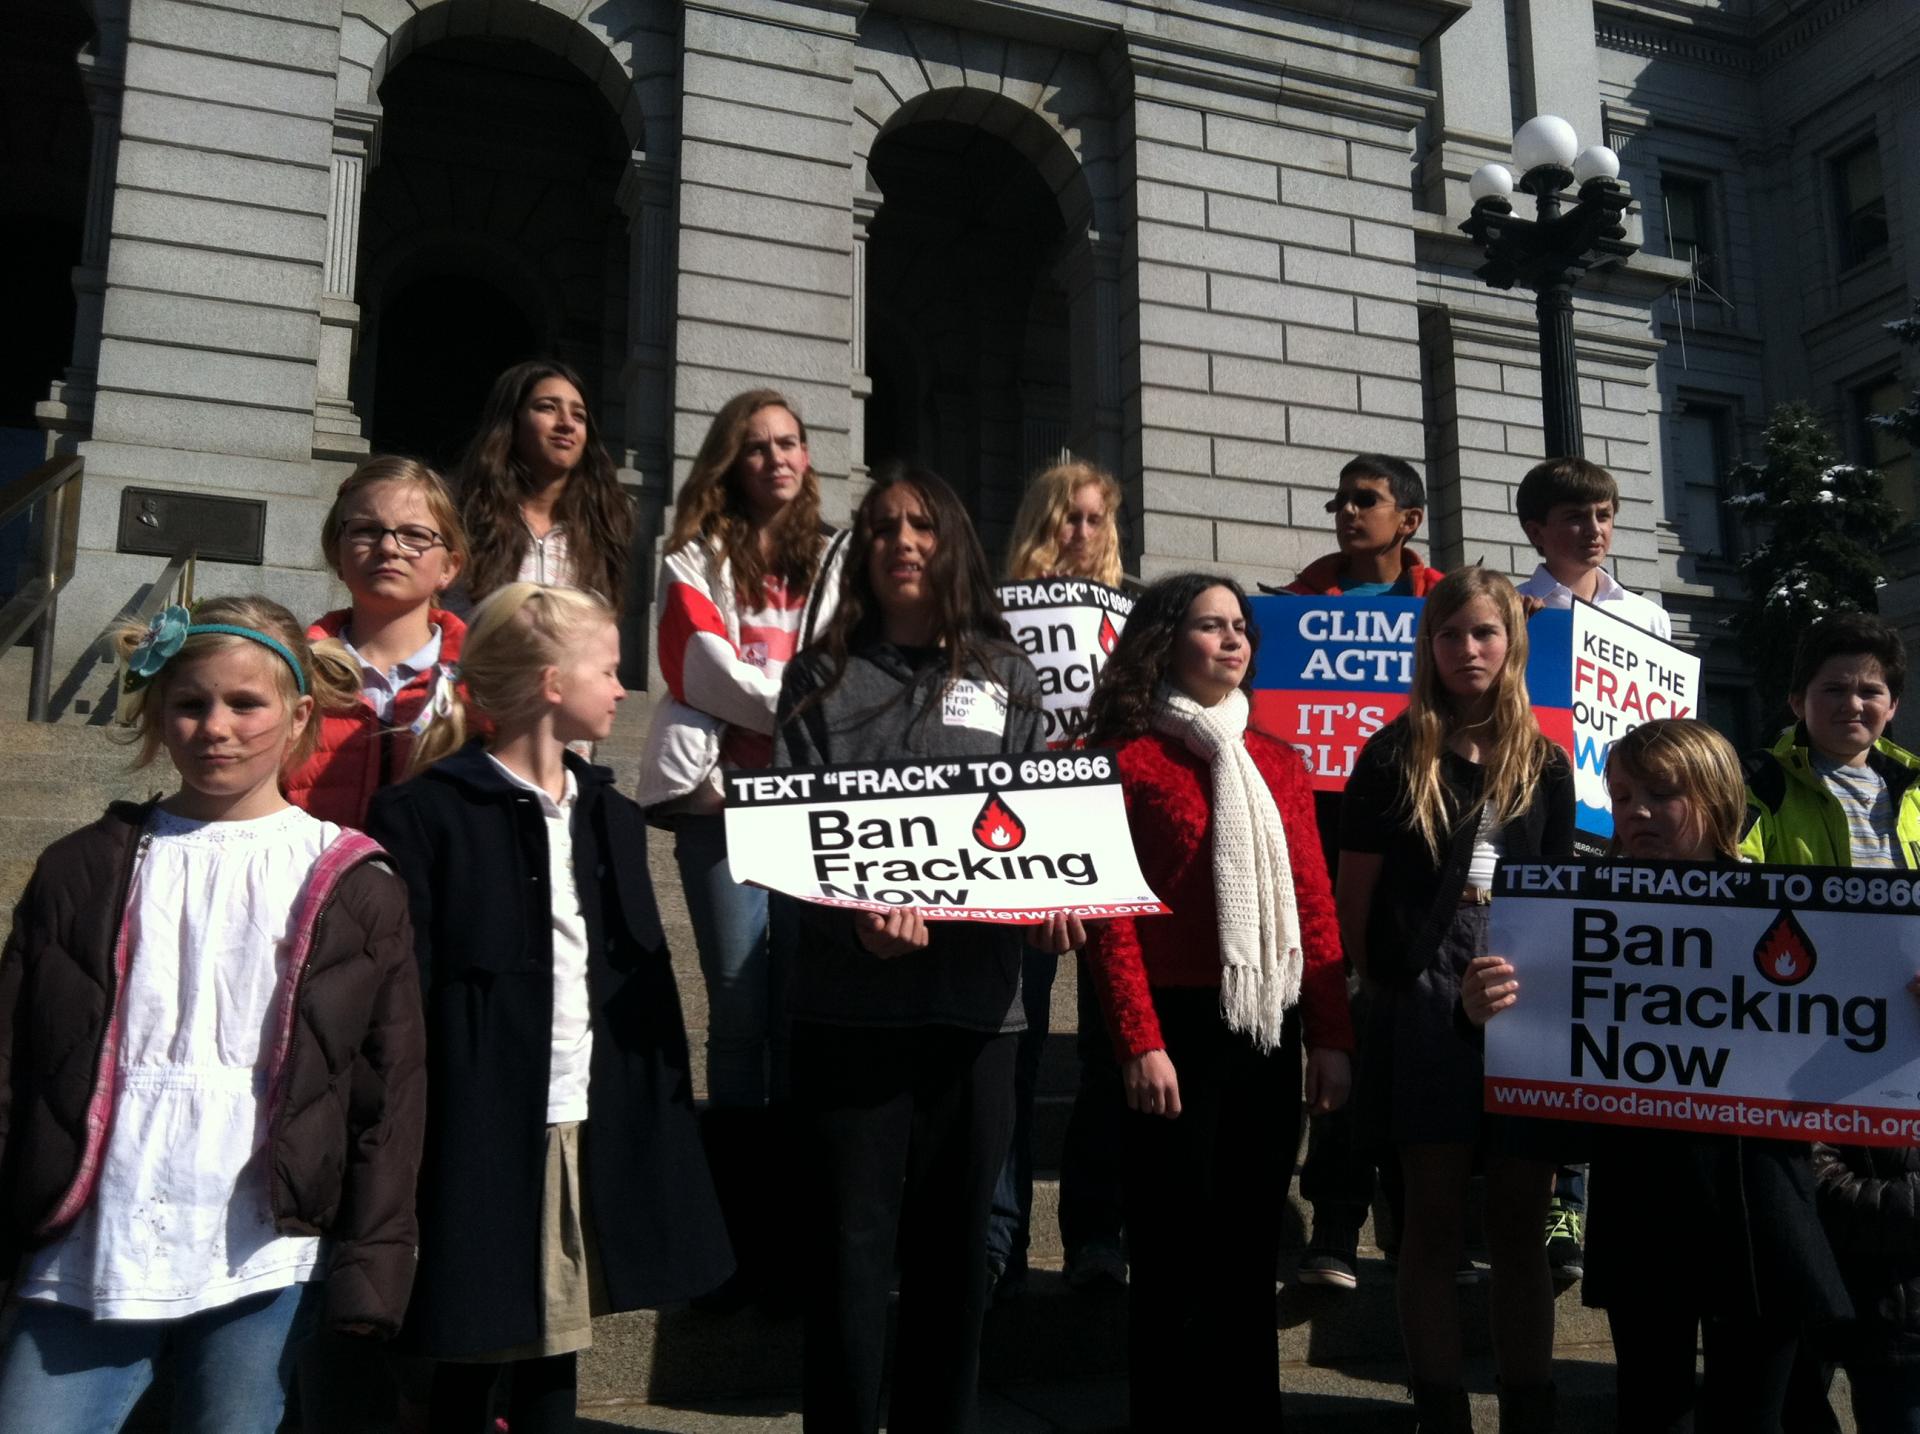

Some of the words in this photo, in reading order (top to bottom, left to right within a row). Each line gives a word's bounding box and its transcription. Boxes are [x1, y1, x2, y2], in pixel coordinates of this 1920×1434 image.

[1090, 585, 1109, 607] TO
[1109, 592, 1134, 616] 6986
[1017, 622, 1077, 655] an
[1298, 610, 1416, 643] CLIM
[1300, 648, 1414, 683] ACTI
[1583, 630, 1639, 672] KEEP
[1645, 659, 1686, 697] THE
[945, 704, 970, 717] No
[1296, 702, 1385, 738] IT’S
[1572, 700, 1618, 737] OUT
[732, 773, 816, 801] TEXT
[823, 764, 960, 796] “FRACK”
[968, 761, 1013, 787] TO
[1020, 756, 1111, 784] 69866
[808, 810, 938, 851] Ban
[813, 848, 1099, 885] Fracking
[1501, 863, 1585, 892] TEXT
[1594, 866, 1750, 899] “FRACK”
[1761, 872, 1812, 901] TO
[818, 882, 970, 906] Now
[1572, 907, 1712, 969] Ban
[1570, 965, 1888, 1053] Fracking
[1569, 1022, 1731, 1089] Now
